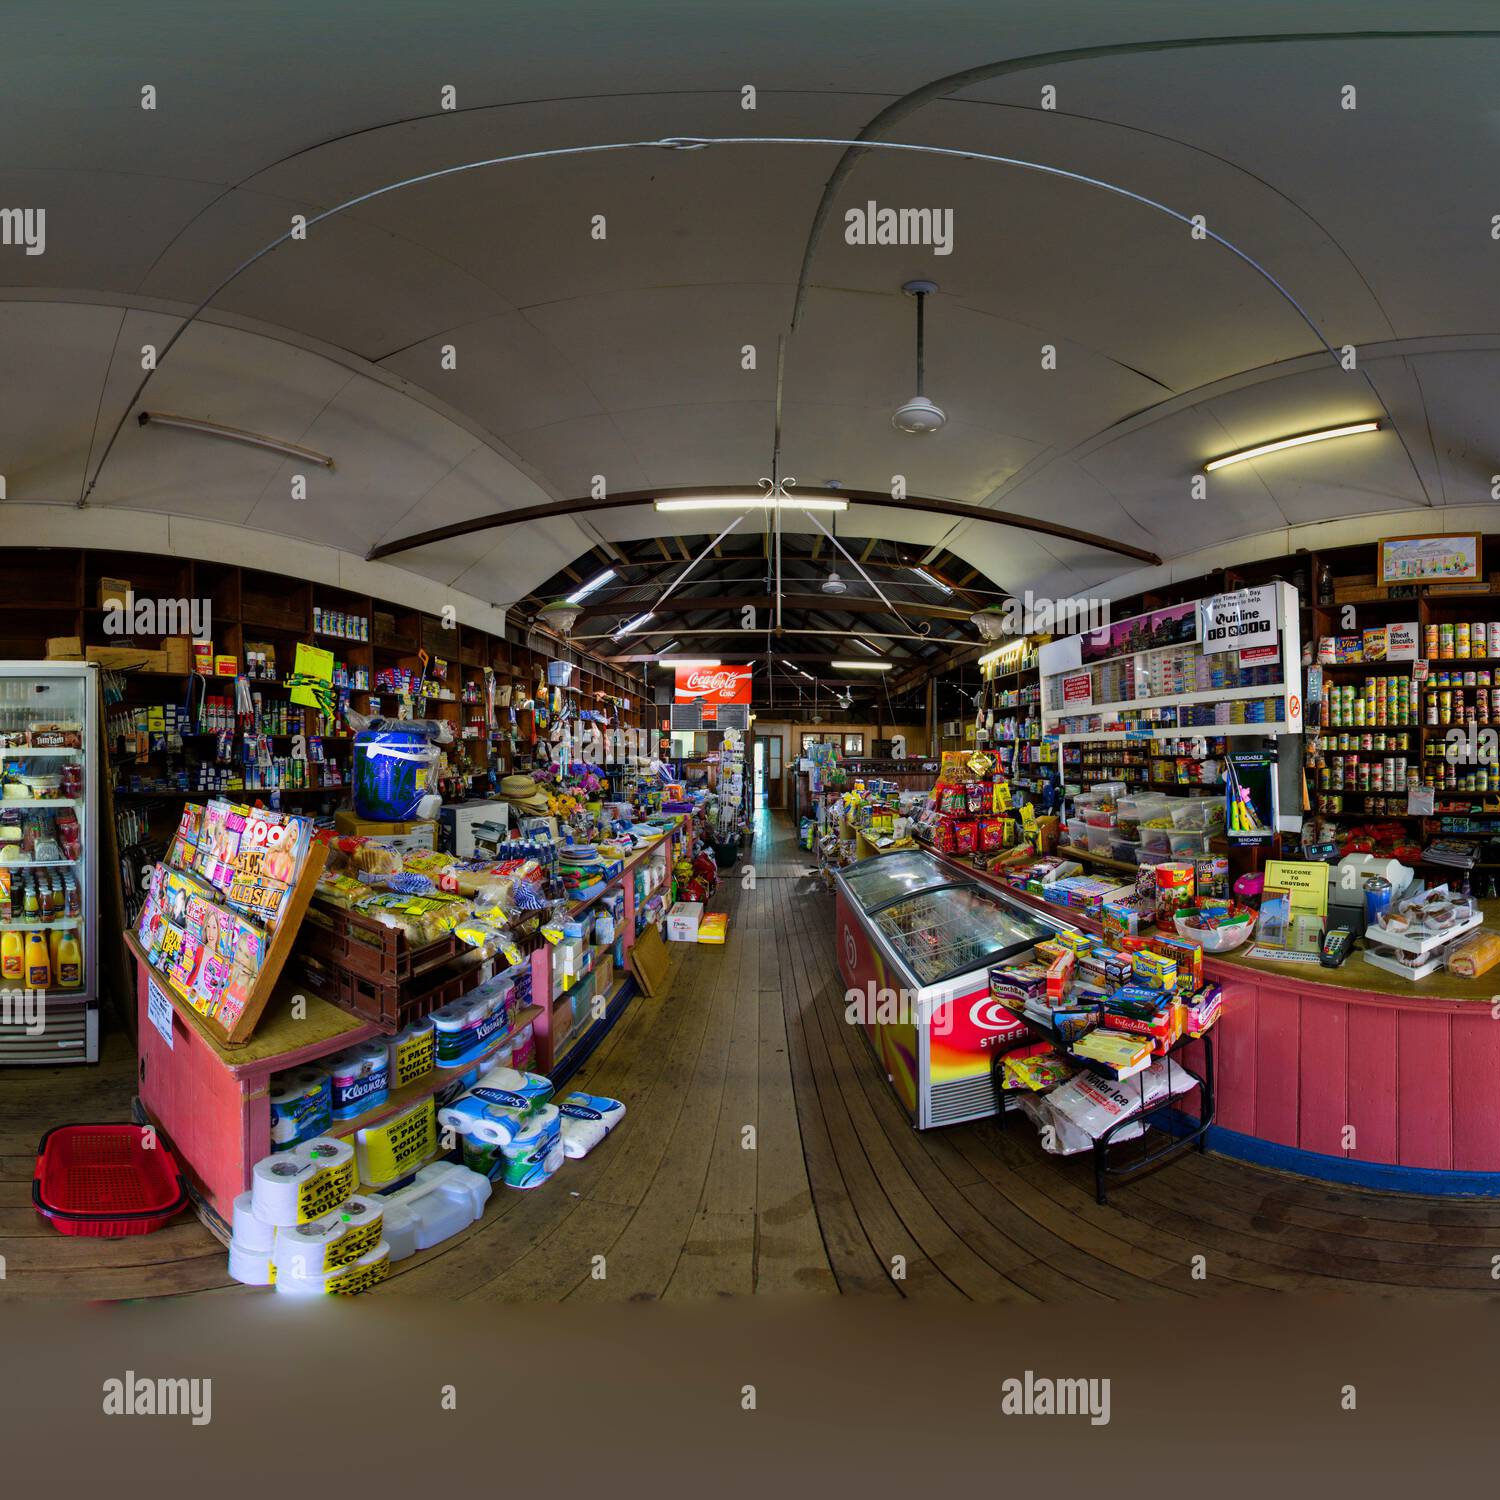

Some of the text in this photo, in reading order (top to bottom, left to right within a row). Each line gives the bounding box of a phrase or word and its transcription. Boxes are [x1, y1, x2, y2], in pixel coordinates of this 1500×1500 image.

[1390, 632, 1409, 640] Wheat
[687, 671, 737, 689] Coca-Cola
[246, 818, 286, 848] ZOO
[1281, 868, 1312, 876] WELCOME
[1122, 987, 1158, 997] OREO
[980, 1027, 1030, 1048] STREET
[407, 1045, 434, 1063] PACK
[398, 1054, 434, 1075] TOILET
[401, 1064, 432, 1084] ROLLS
[341, 1078, 388, 1102] Kleenex
[475, 1087, 527, 1108] Sorbent
[1085, 1070, 1114, 1094] Water
[1109, 1090, 1129, 1107] Ice
[560, 1104, 600, 1120] Sorbent
[400, 1116, 428, 1133] PACK
[391, 1127, 428, 1154] TOILET
[395, 1137, 428, 1163] ROLLS
